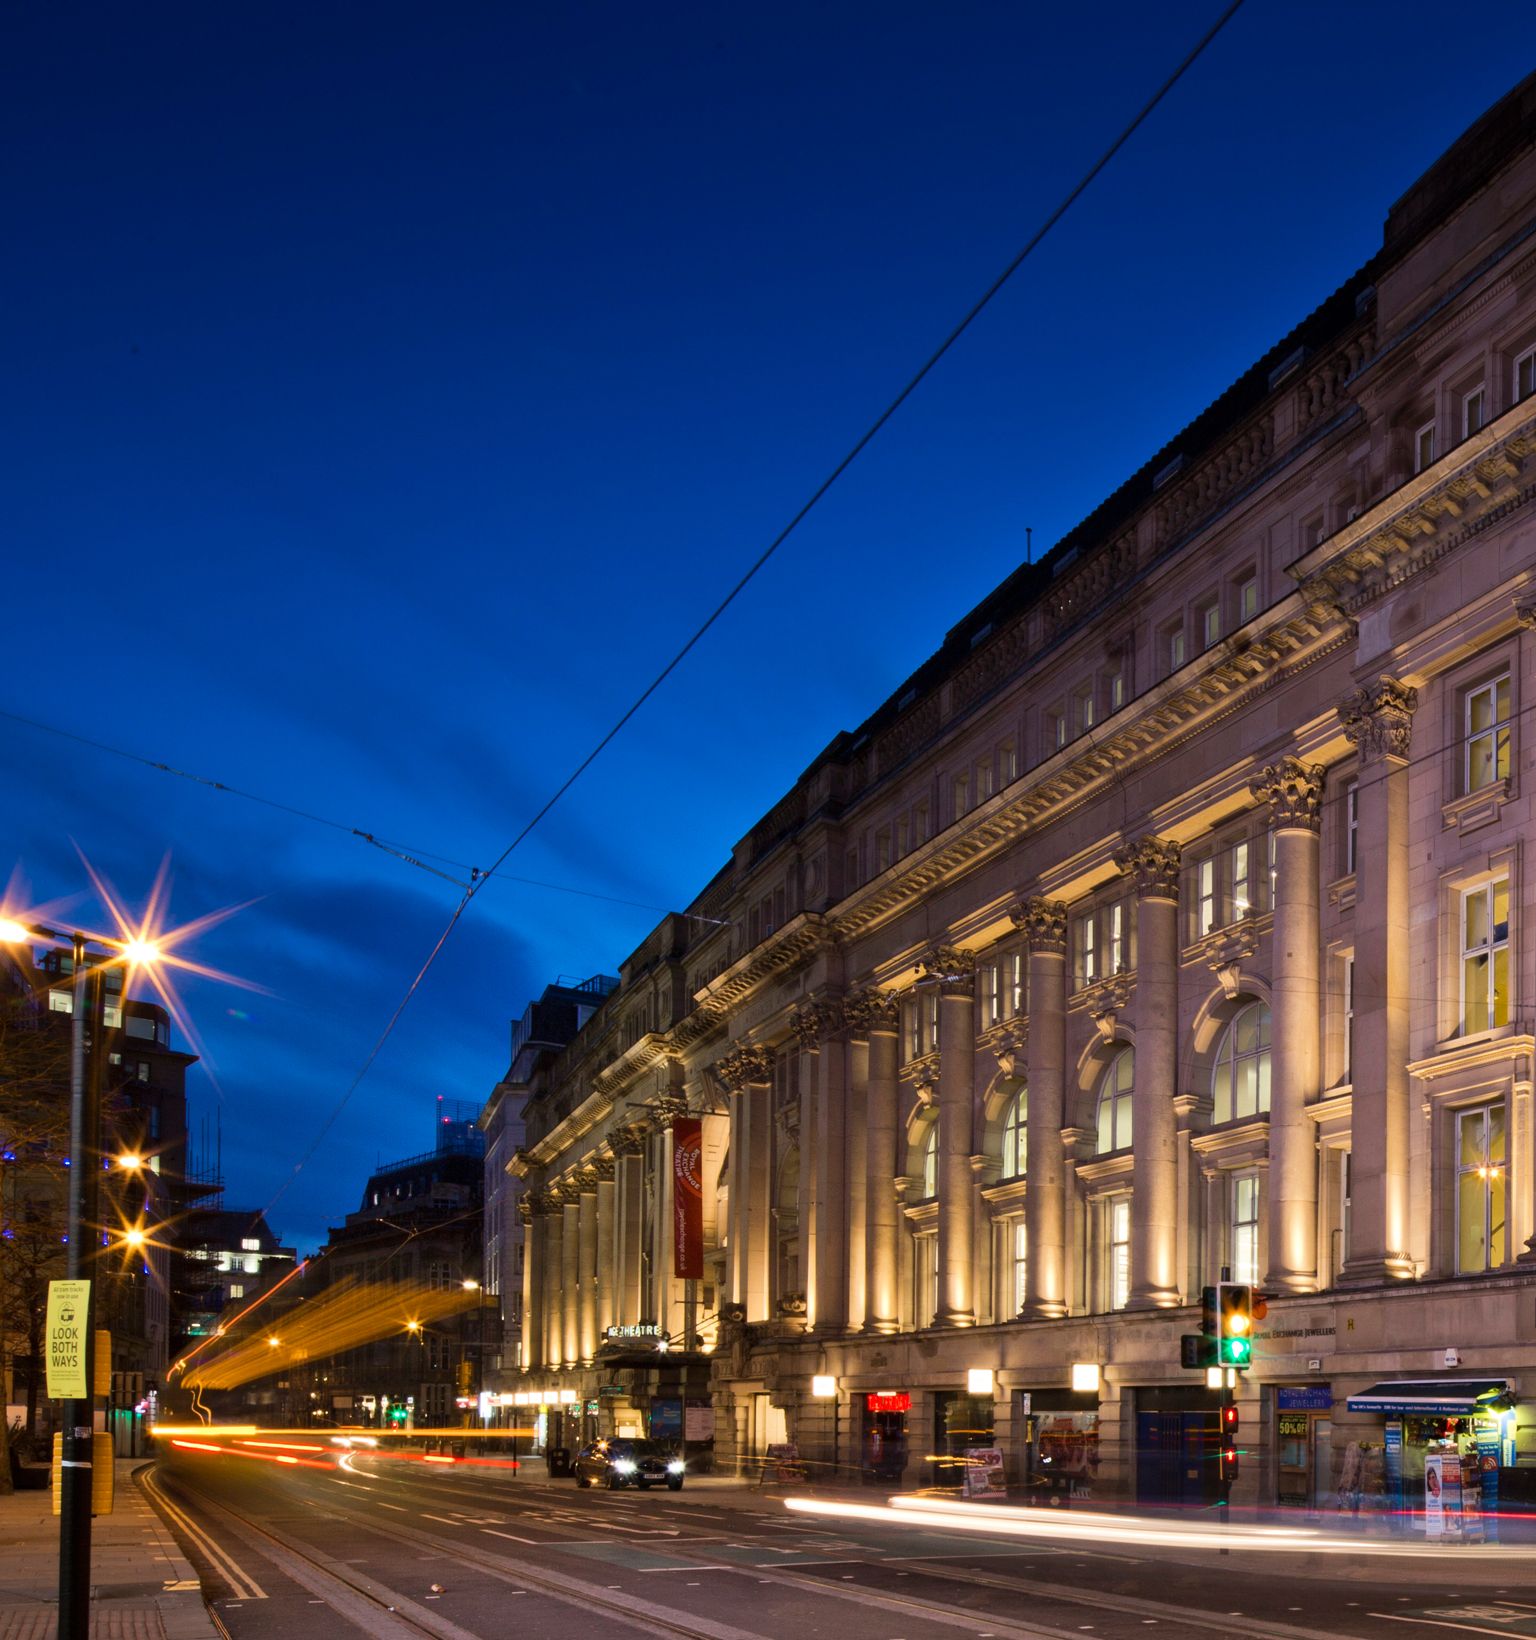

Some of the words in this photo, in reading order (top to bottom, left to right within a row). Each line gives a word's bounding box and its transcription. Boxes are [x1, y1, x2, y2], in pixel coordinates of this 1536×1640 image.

[674, 1145, 685, 1178] THEATRE
[682, 1152, 700, 1190] EXCHANGE
[1347, 1319, 1354, 1330] H
[52, 1327, 79, 1340] LOOK
[620, 1325, 659, 1337] THEATRE
[1272, 1329, 1304, 1339] EXCHANGE
[1304, 1327, 1336, 1338] JEWELLERS
[51, 1341, 78, 1354] BOTH
[51, 1355, 78, 1368] WAYS
[1289, 1399, 1325, 1409] JEWELLERS
[1279, 1422, 1297, 1434] 50%
